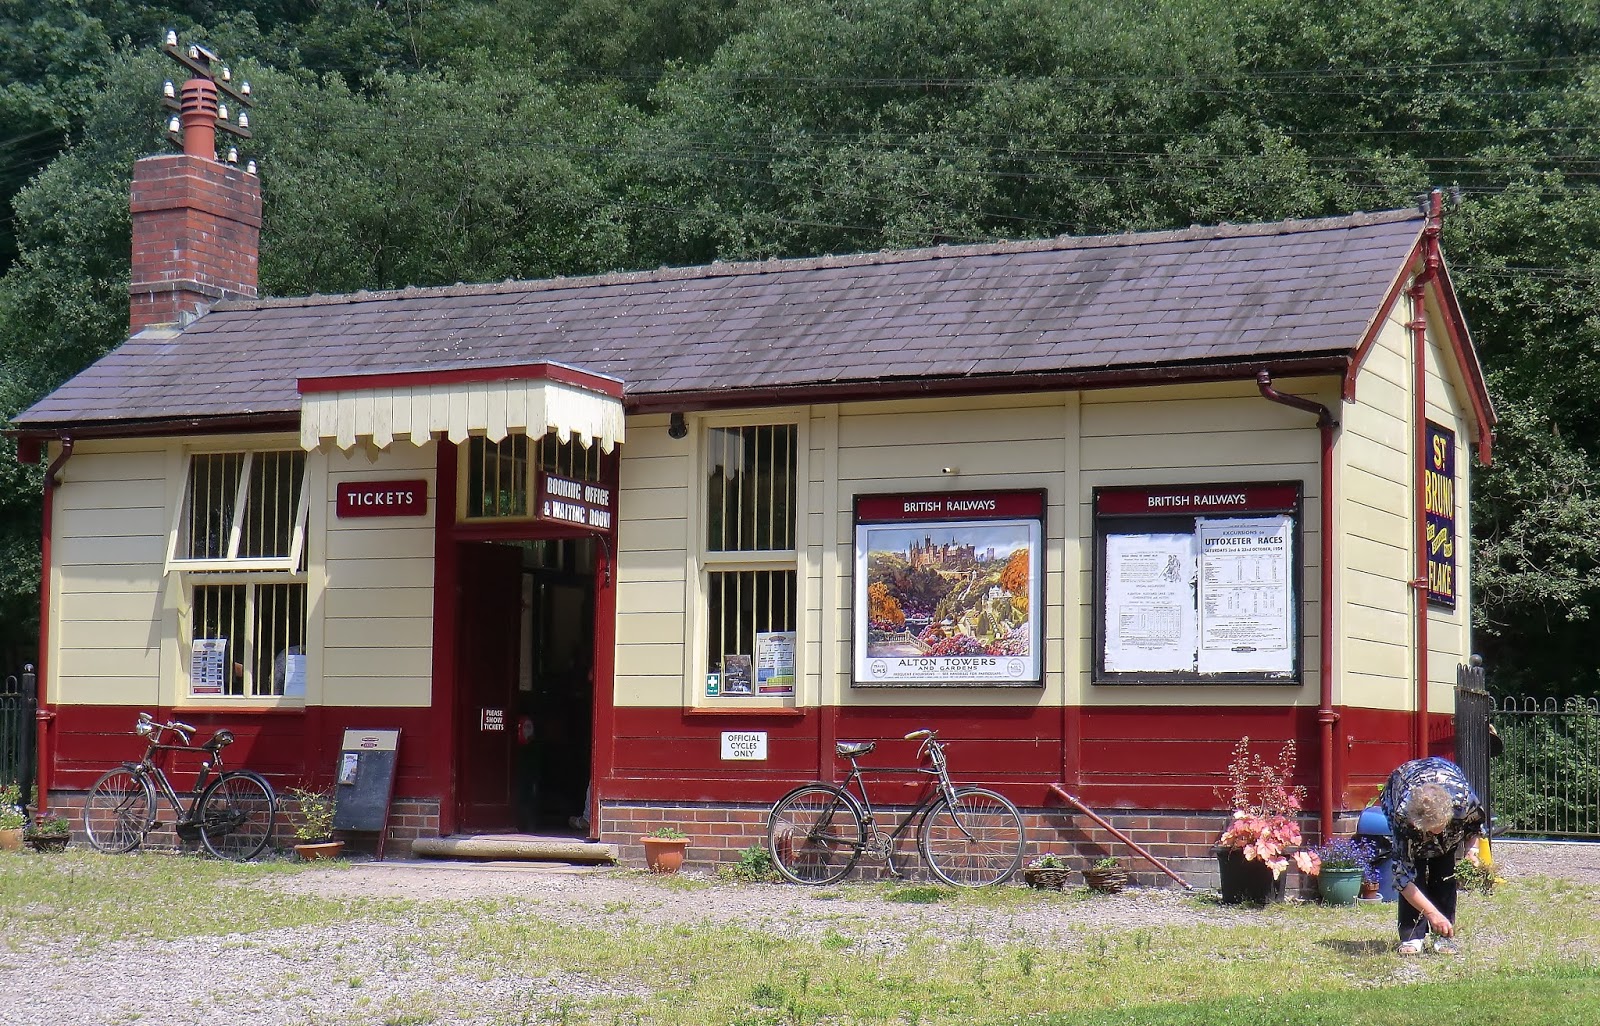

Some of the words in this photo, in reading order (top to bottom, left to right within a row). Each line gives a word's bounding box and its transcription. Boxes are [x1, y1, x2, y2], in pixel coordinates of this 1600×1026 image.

[348, 491, 413, 506] TICKETS
[547, 477, 581, 500] BOOKING
[584, 485, 610, 506] OFFICE
[1425, 469, 1453, 520] BRUNO
[904, 502, 941, 512] BRITISH
[946, 500, 996, 510] RAILWAYS
[1148, 495, 1190, 507] BRITISH
[1194, 494, 1246, 506] RAILWAYS
[544, 501, 550, 516] &
[552, 501, 586, 523] WAITING
[589, 508, 611, 528] ROOM
[1205, 538, 1252, 546] UTTOXETER
[1428, 560, 1452, 597] FLAKE
[898, 658, 936, 666] ALTON
